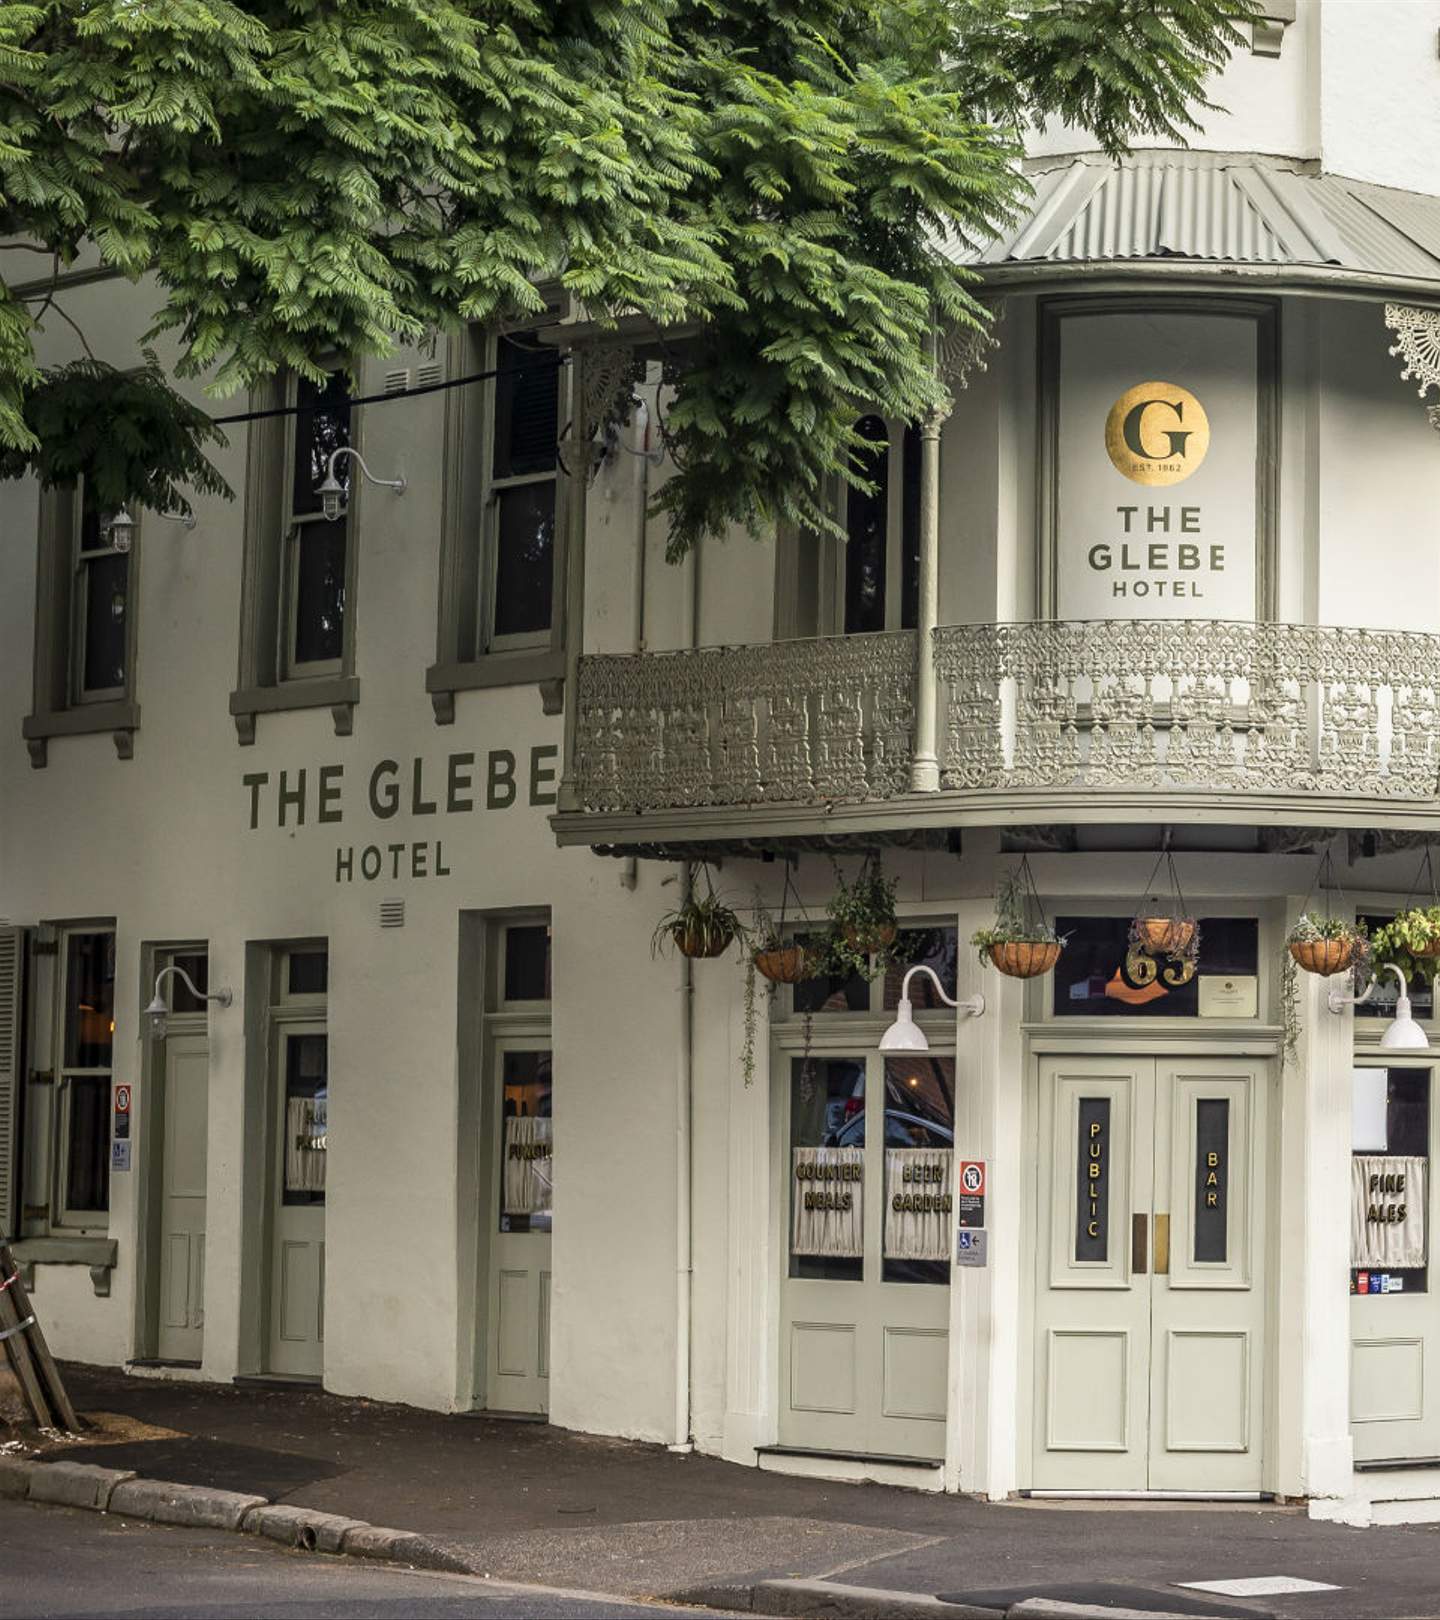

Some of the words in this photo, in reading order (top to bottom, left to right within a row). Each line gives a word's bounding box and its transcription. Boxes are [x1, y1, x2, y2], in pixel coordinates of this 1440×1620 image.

[1123, 400, 1195, 461] G
[1117, 506, 1201, 533] THE
[1088, 544, 1225, 571] GLEBE
[1113, 581, 1203, 597] HOTEL
[243, 764, 344, 829] THE
[369, 745, 558, 820] GLEBE
[336, 841, 450, 882] HOTEL
[796, 1162, 862, 1182] COUNTER
[902, 1164, 945, 1183] BEER
[1088, 1123, 1101, 1237] PUBLIC
[1206, 1152, 1218, 1207] BAR
[1369, 1174, 1405, 1193] FINE
[804, 1191, 852, 1211] MEALS
[892, 1193, 953, 1214] GARDEN
[1367, 1203, 1408, 1224] ALES
